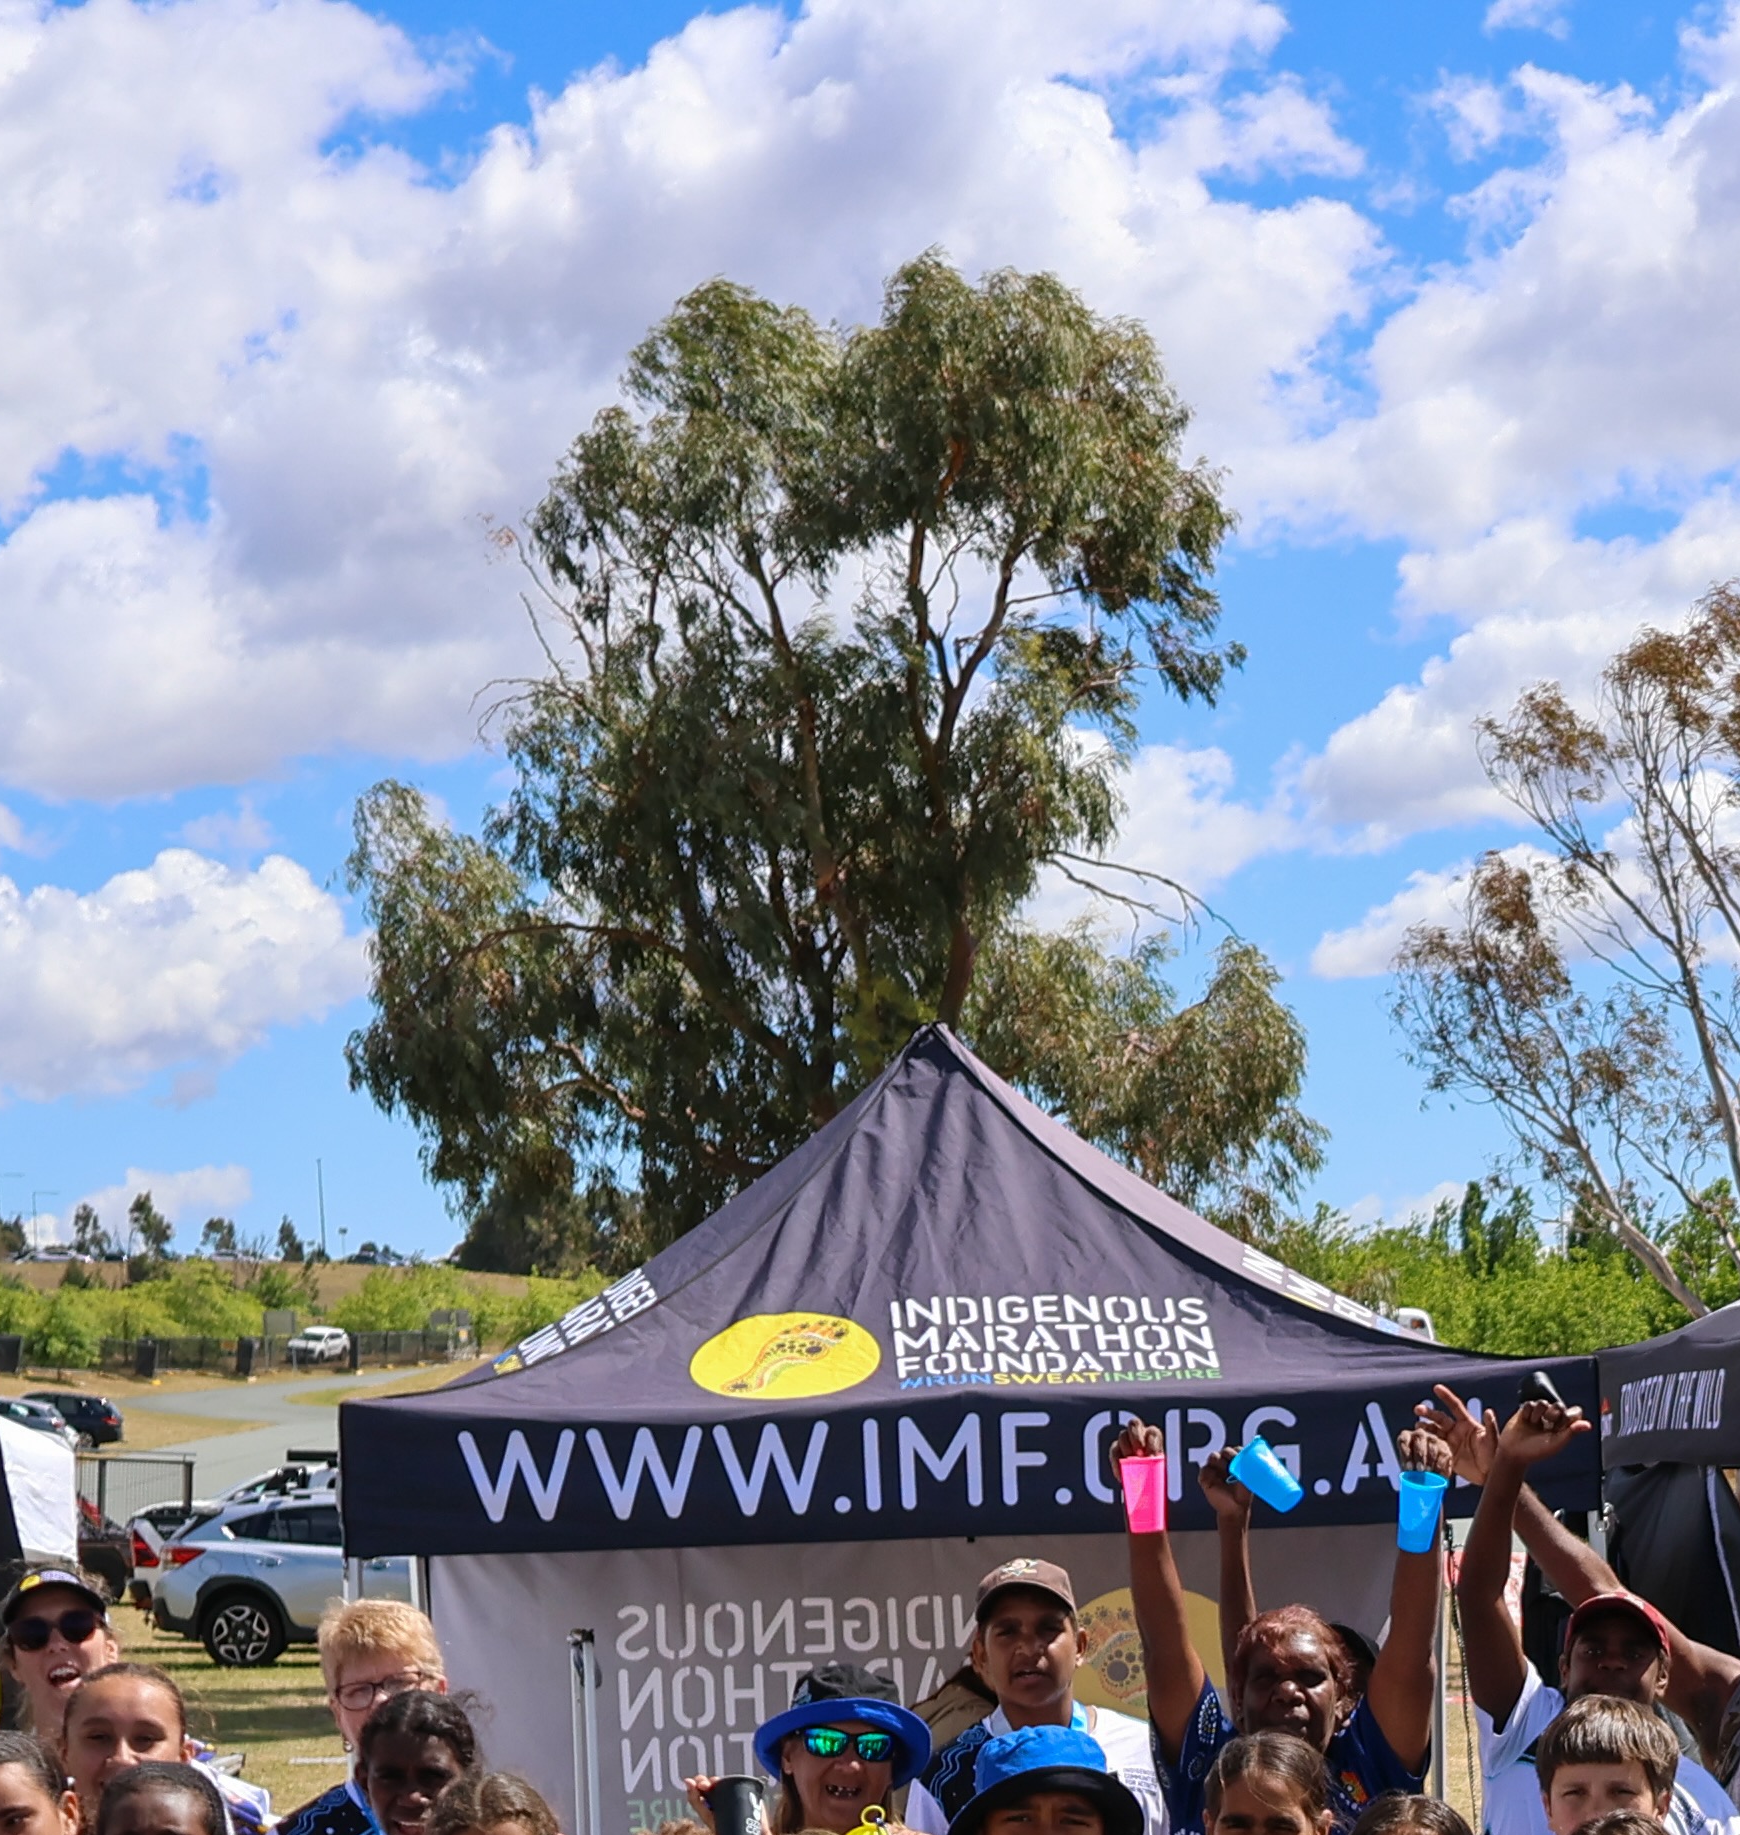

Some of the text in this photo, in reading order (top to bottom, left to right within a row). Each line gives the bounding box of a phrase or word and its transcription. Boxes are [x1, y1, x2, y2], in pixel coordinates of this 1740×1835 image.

[890, 1294, 1209, 1328] INDIGENOUS
[893, 1323, 1216, 1356] MARATHON
[896, 1351, 1221, 1380] FOUNDATION
